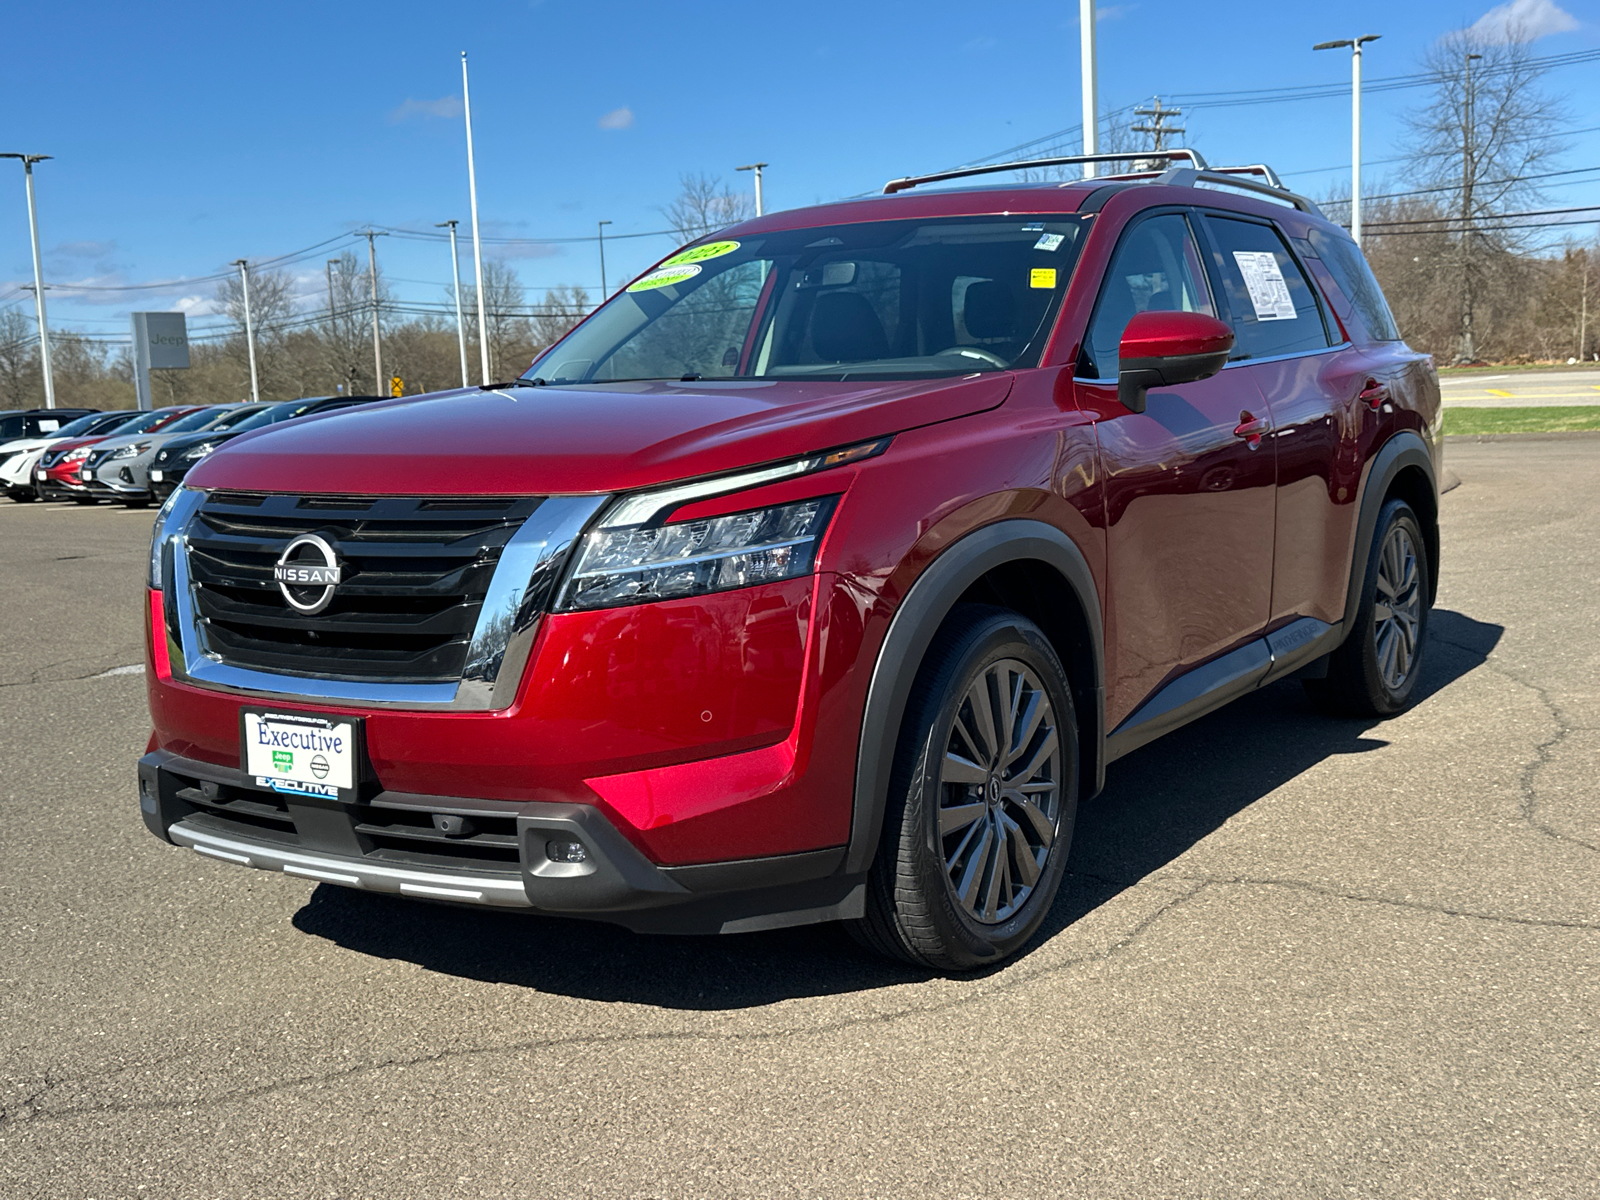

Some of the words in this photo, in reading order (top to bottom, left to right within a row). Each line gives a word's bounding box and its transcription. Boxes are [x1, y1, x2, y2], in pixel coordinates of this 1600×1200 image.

[151, 333, 184, 347] Jeep
[274, 567, 338, 582] NISSAN
[257, 722, 343, 754] Executive
[274, 751, 292, 762] Jeep
[256, 776, 339, 797] EXECUTIVE
